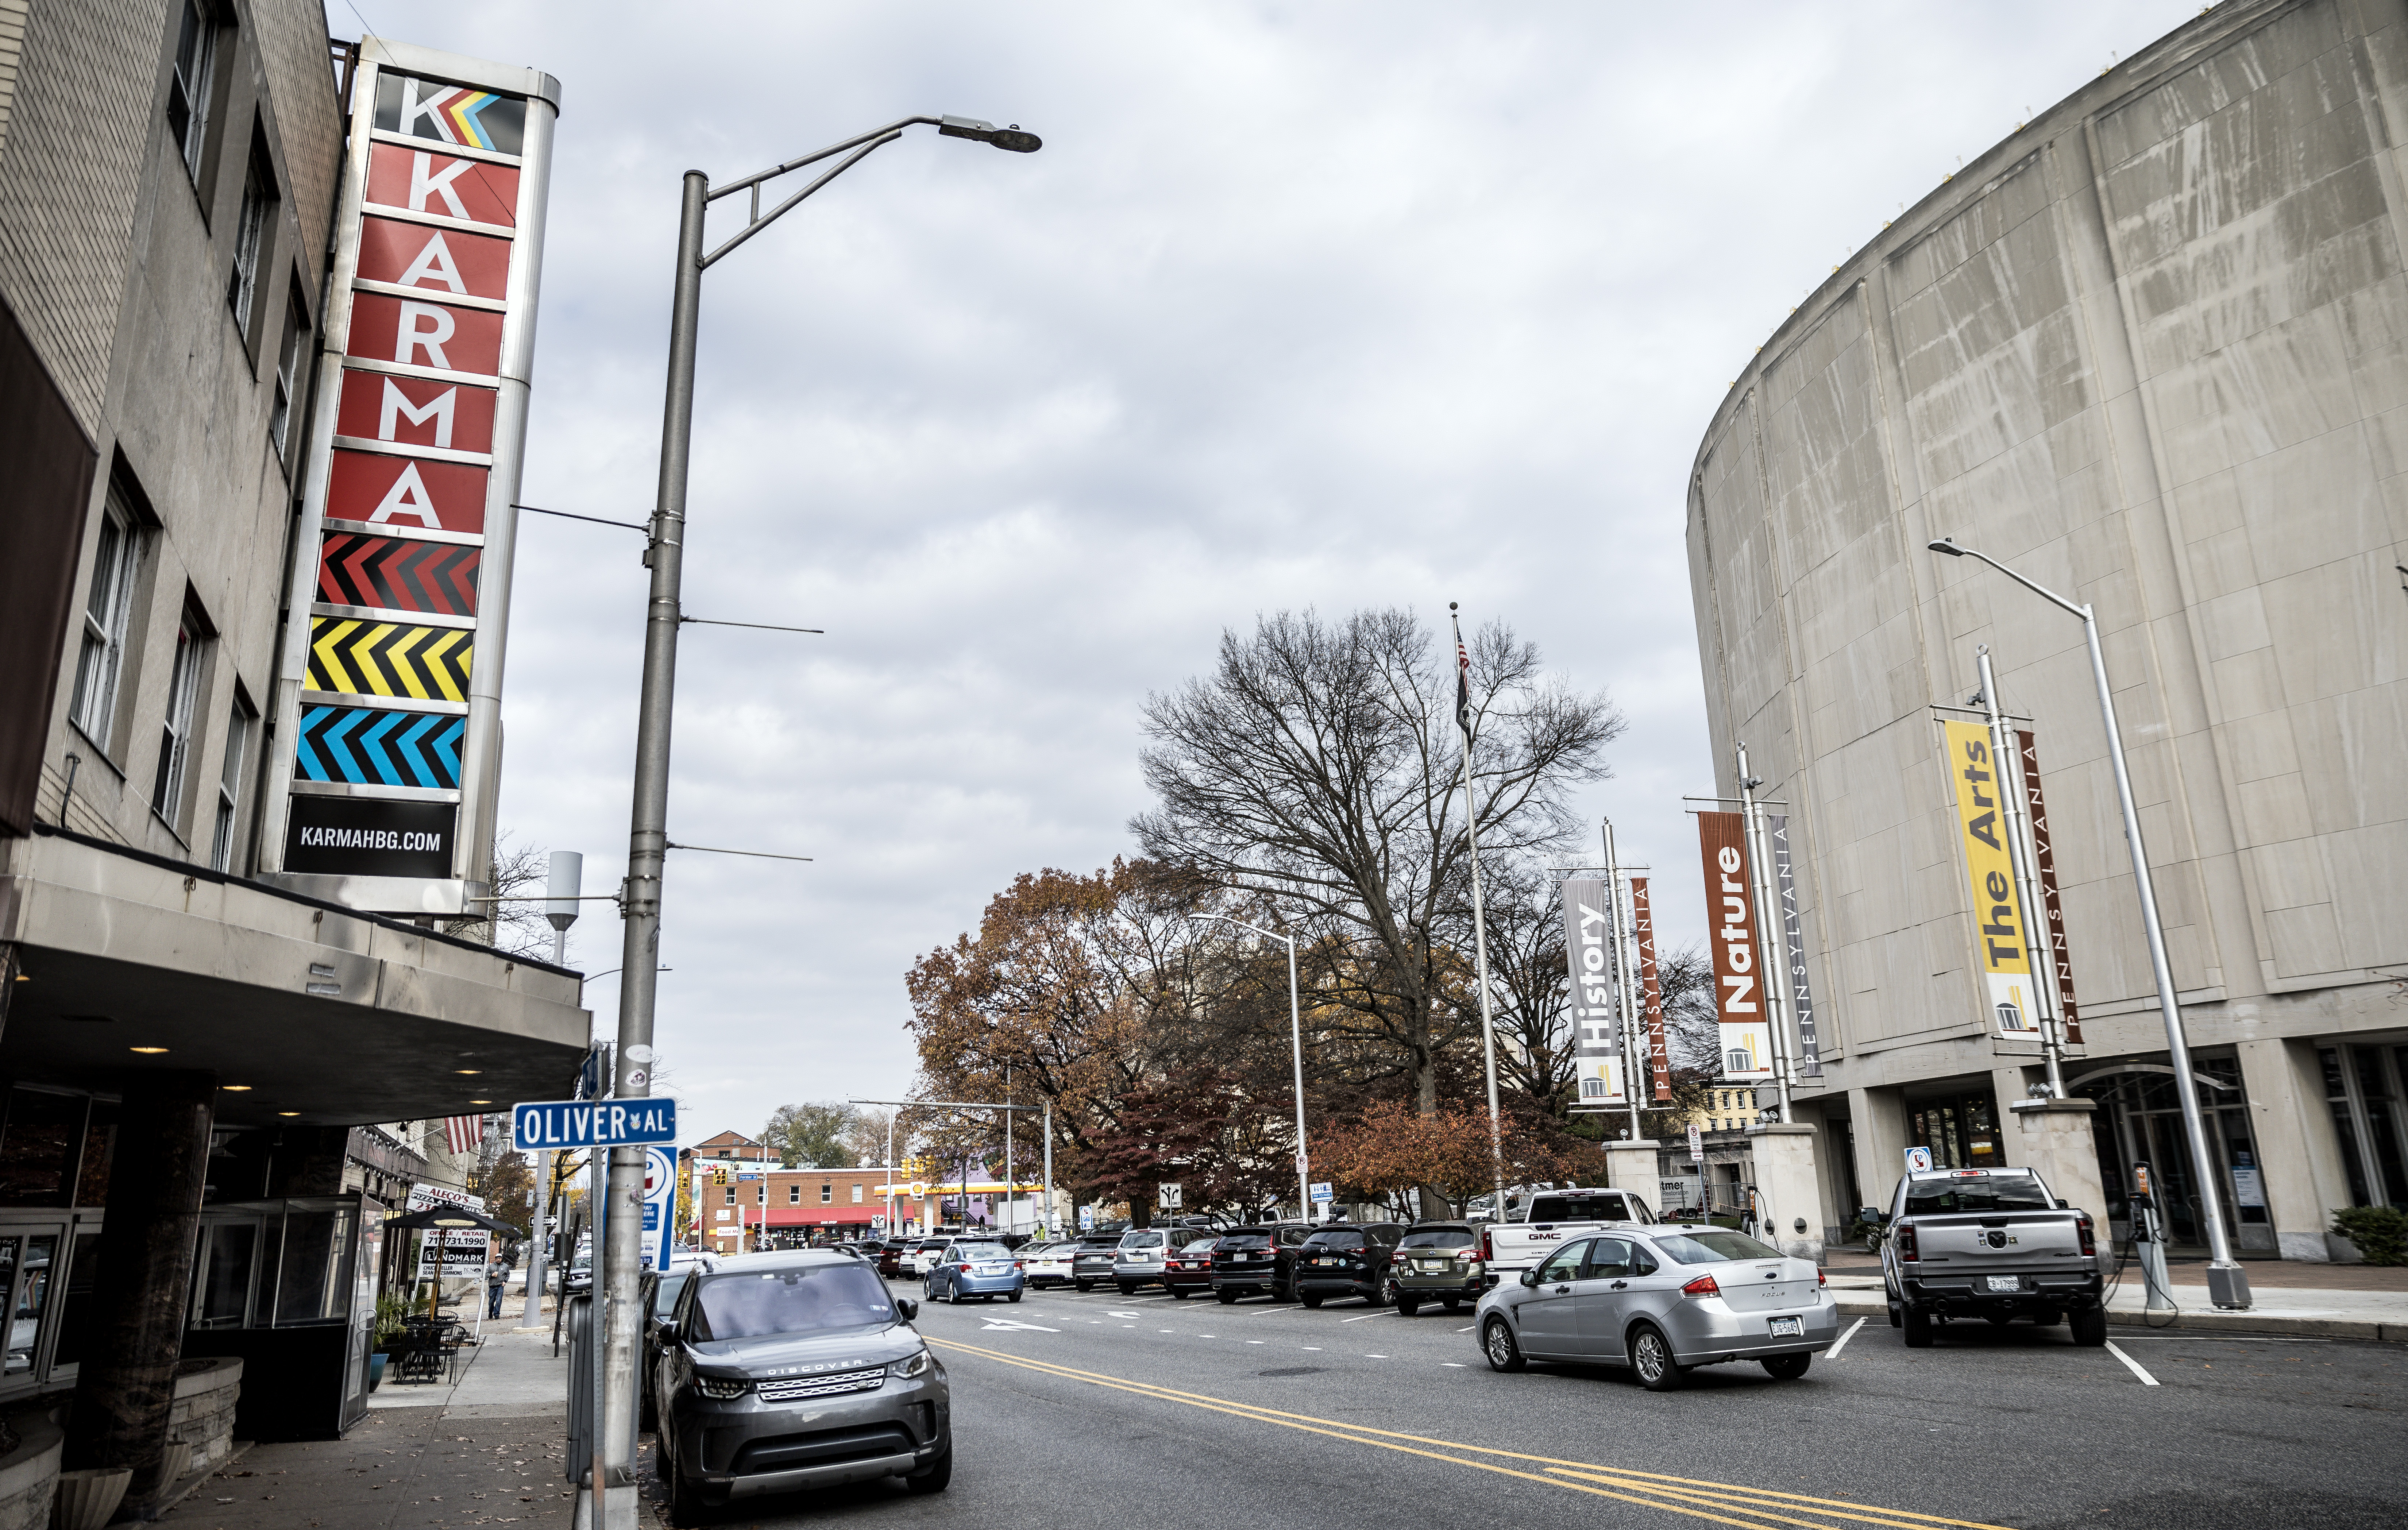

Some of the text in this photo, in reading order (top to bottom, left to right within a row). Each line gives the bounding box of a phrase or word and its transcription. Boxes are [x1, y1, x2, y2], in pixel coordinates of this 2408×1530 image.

[368, 151, 476, 529] KARMA
[301, 827, 440, 851] KARMAHBG.COM
[1965, 740, 2021, 967] The Arts
[1718, 846, 1757, 1013] Nature
[2022, 746, 2079, 1026] PENNSYLVANIA
[1579, 903, 1612, 1048] History
[1634, 888, 1670, 1089] PENNSYLVANIA
[1773, 827, 1819, 1064] PENNSYLVANIA
[524, 1106, 668, 1144] OLIVER AL
[412, 1193, 434, 1202] PIZZA
[429, 1188, 470, 1203] ALECO'S
[1659, 1181, 1683, 1190] itmer
[428, 1237, 485, 1245] 71731.1990
[767, 1357, 873, 1375] DISCOVERY
